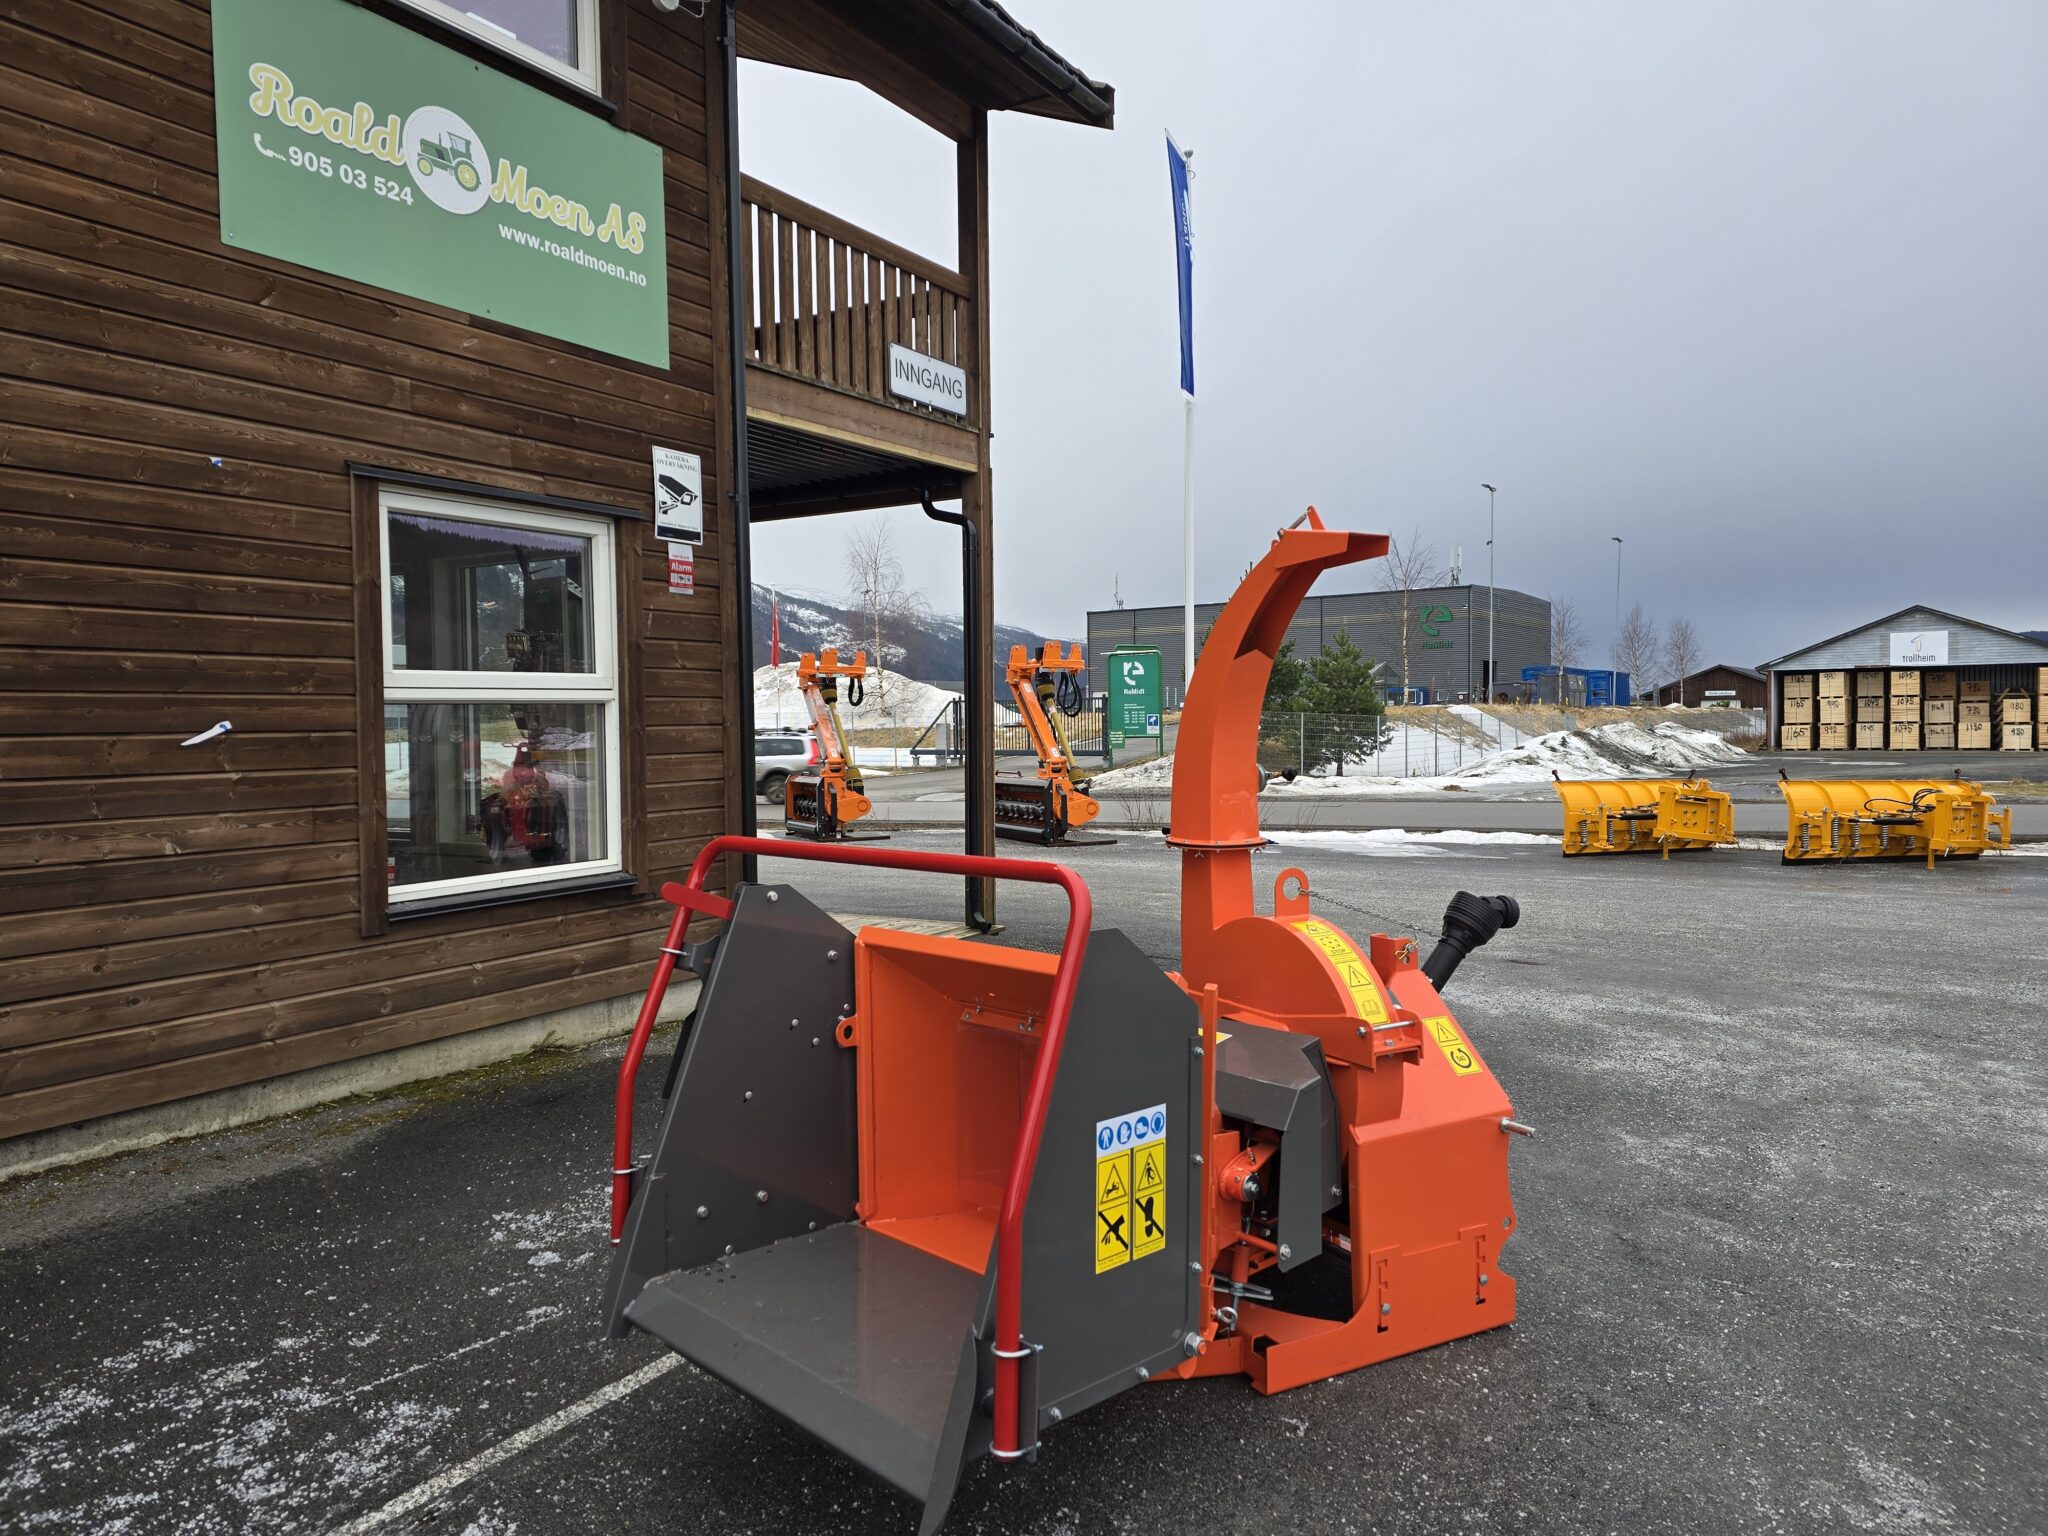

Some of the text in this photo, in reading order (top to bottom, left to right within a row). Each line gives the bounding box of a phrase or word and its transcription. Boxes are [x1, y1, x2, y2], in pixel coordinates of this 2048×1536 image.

[248, 62, 647, 256] Roald Moen AS
[289, 146, 414, 206] 905 03 524
[498, 221, 648, 288] www.roaldmoen.no
[895, 357, 963, 399] INNGANG
[664, 453, 690, 464] KAMERA
[656, 458, 698, 473] OVERVÅKNING
[671, 562, 692, 573] Alarm
[1902, 653, 1936, 663] trollheim
[1790, 699, 1805, 709] 1165
[1826, 699, 1839, 709] 990
[1786, 727, 1808, 741] 1165
[1824, 726, 1837, 734] 990
[1895, 724, 1914, 734] 1075
